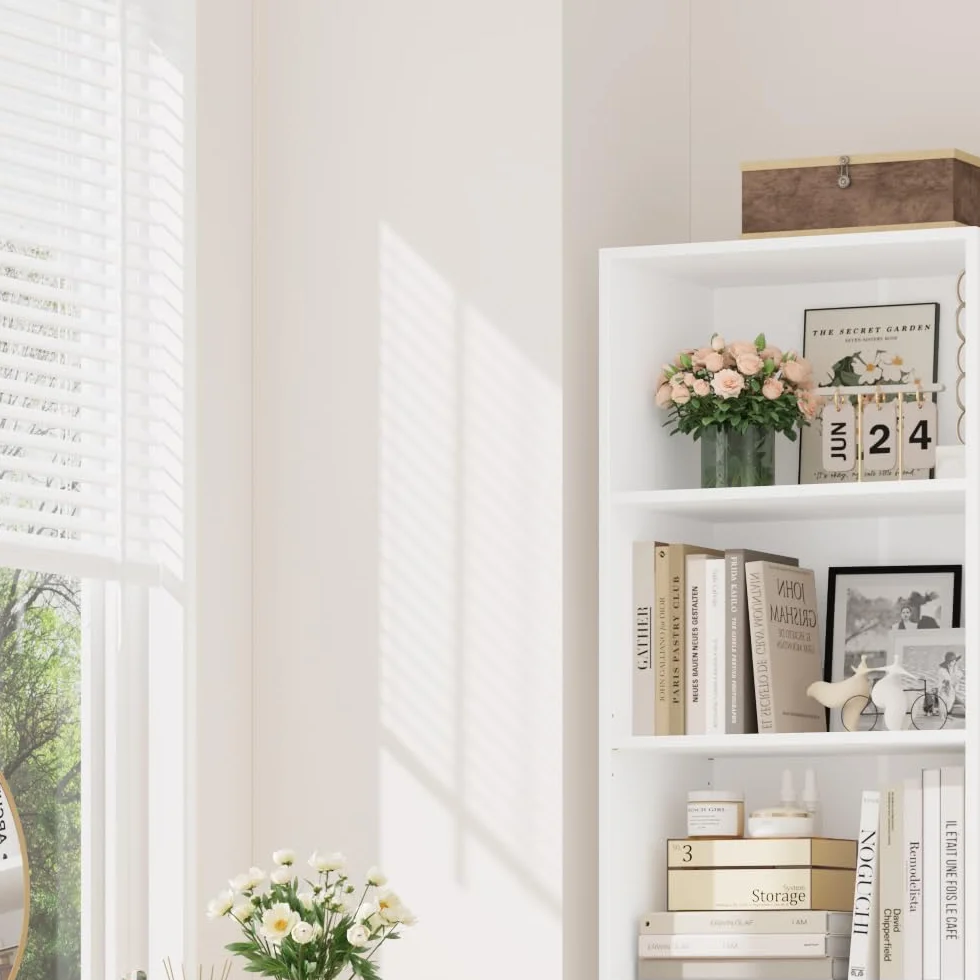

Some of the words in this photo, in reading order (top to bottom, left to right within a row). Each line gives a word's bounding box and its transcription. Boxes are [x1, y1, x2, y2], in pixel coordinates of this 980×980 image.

[812, 329, 834, 337] THE
[840, 326, 882, 336] SECRET
[886, 324, 932, 332] GARDEN
[830, 422, 847, 461] JUN
[869, 424, 890, 454] 2
[908, 420, 932, 450] 4
[672, 576, 680, 609] CLUB
[637, 606, 649, 670] GATHER
[672, 615, 680, 662] PASTRY
[672, 666, 680, 704] PARIS
[946, 820, 958, 830] IL
[682, 844, 693, 862] 3
[853, 829, 876, 935] NOGUCHI
[909, 841, 920, 912] Remodelista
[946, 859, 958, 878] UNE
[752, 888, 806, 906] Storage
[946, 880, 958, 900] FOIS
[893, 908, 902, 932] David
[946, 902, 958, 914] LE
[881, 908, 892, 962] Chipperfield
